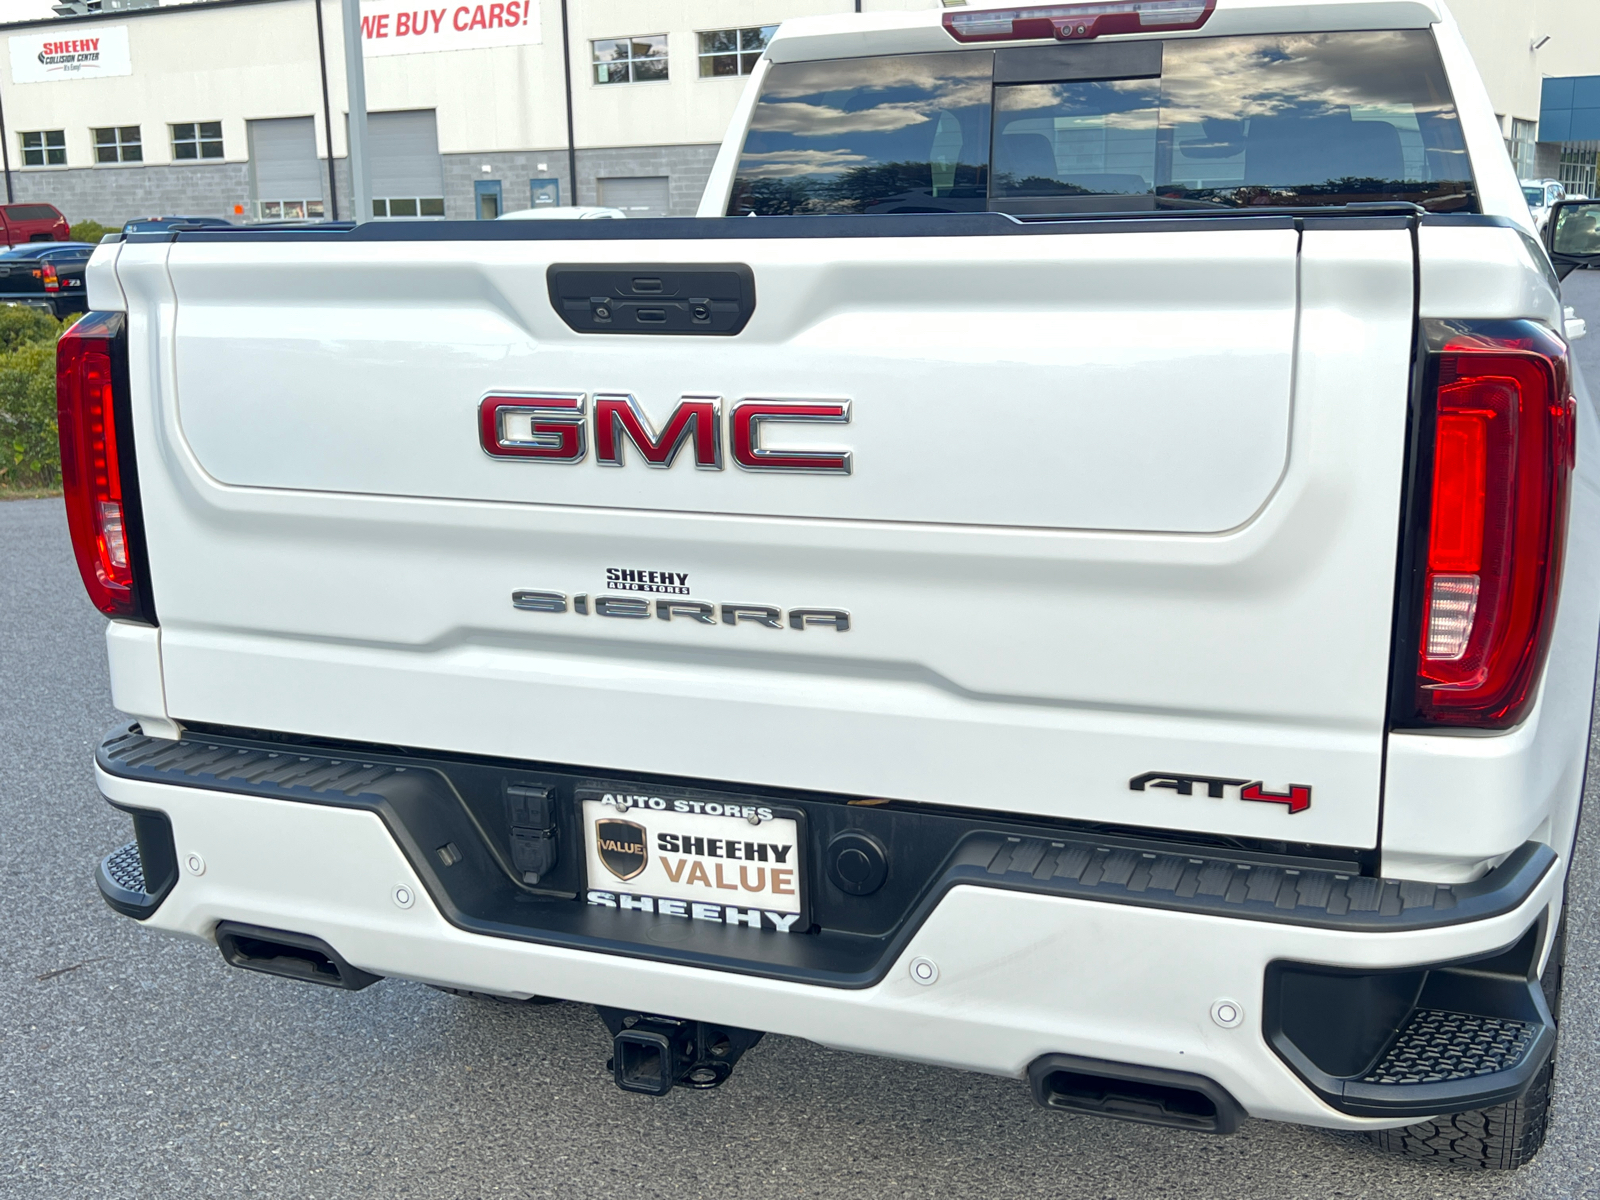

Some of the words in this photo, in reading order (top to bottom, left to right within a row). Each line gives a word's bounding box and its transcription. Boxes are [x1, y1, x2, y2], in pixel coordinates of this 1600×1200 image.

[361, 14, 390, 39] WE
[396, 8, 447, 37] BUY
[453, 0, 530, 32] CARS!
[43, 38, 99, 55] SHEEHY
[45, 54, 75, 65] COLLISION
[77, 52, 99, 62] CENTER
[478, 390, 852, 475] GMC
[606, 568, 689, 586] SHEEHY
[608, 581, 639, 591] AUTO
[643, 584, 689, 594] STORES
[511, 588, 851, 632] SIERRA
[601, 793, 667, 811] AUTO
[674, 799, 774, 821] STORES
[1129, 770, 1312, 814] AT4
[600, 838, 645, 855] VALUE
[657, 832, 793, 864] SHEEHY
[659, 855, 796, 895] VALUE
[587, 890, 801, 933] SHEEHY
